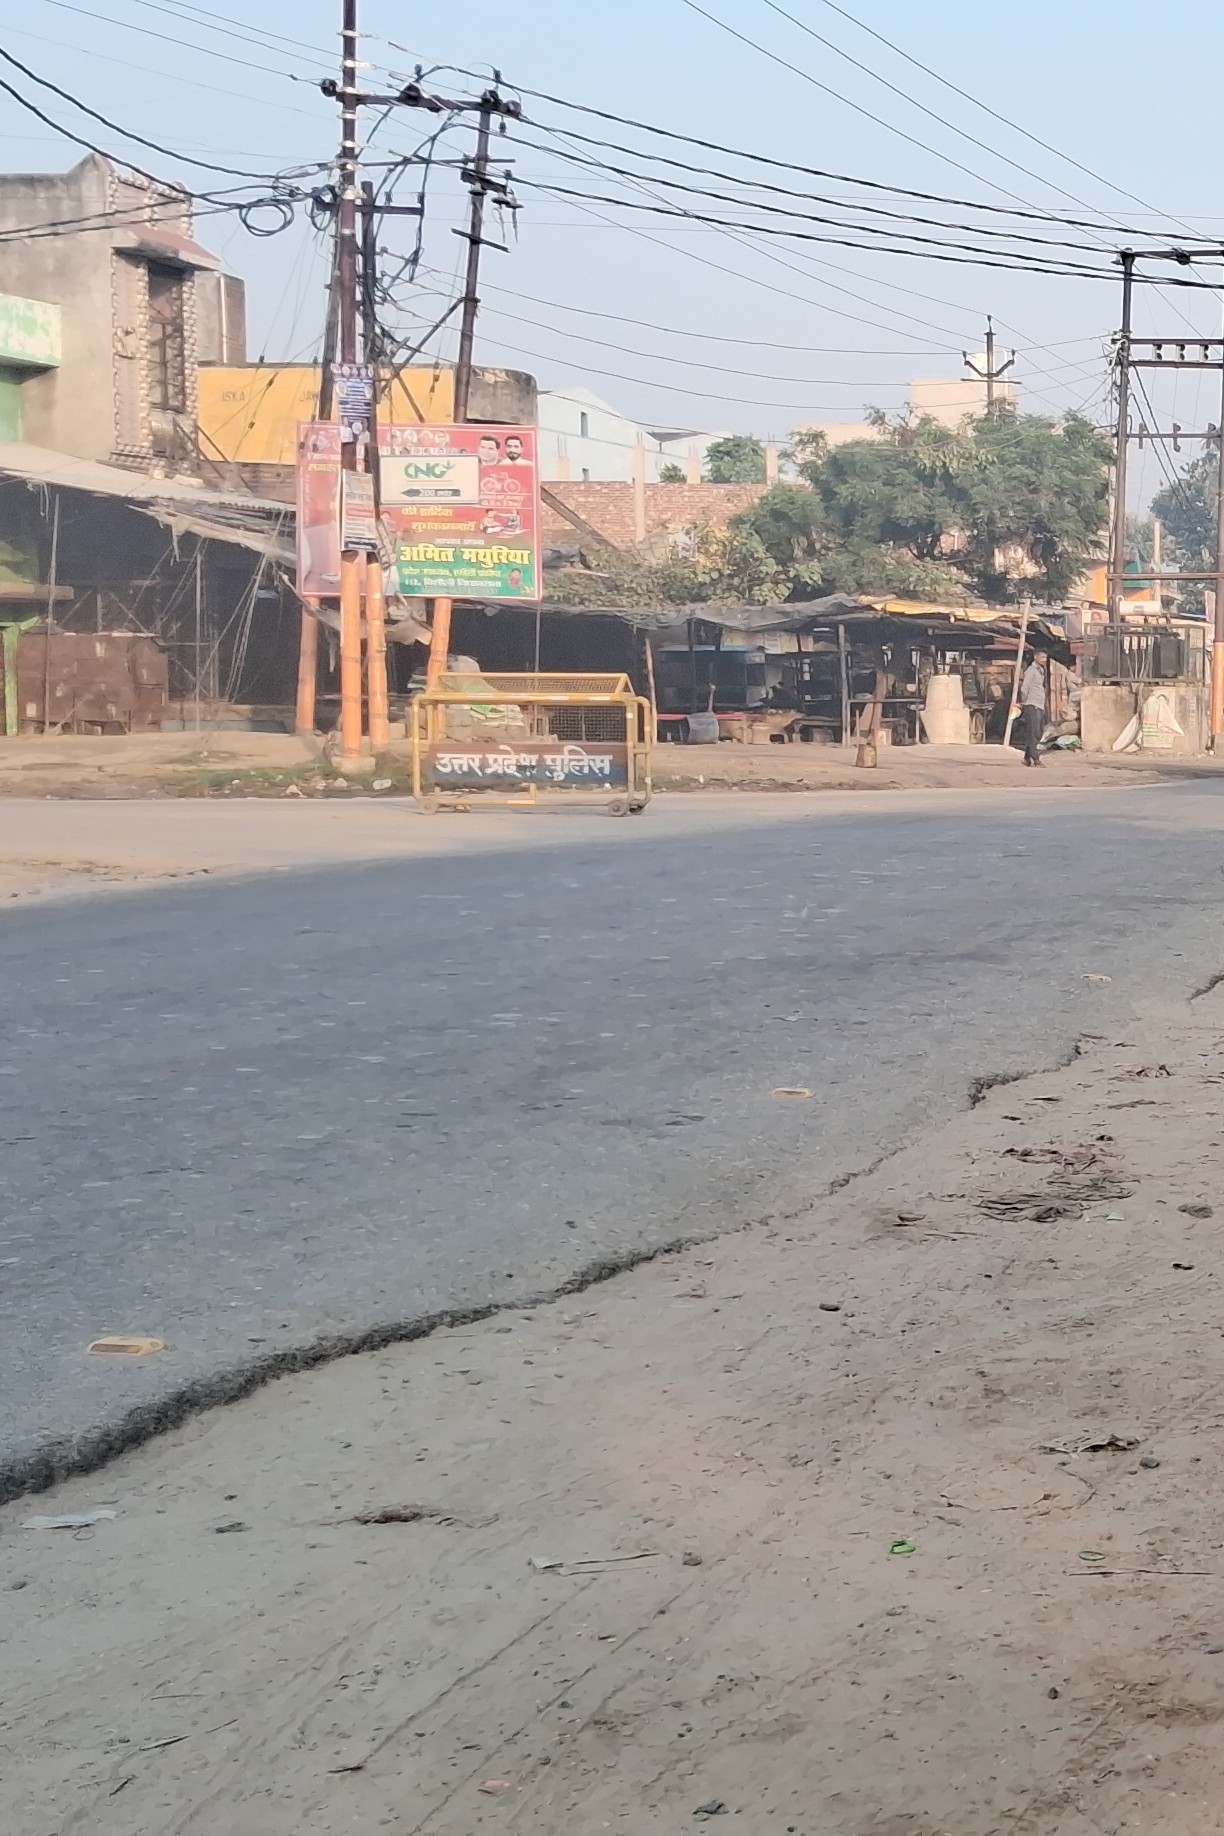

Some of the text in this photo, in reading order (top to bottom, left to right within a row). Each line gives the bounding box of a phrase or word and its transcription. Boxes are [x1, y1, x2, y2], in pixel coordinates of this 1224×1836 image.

[404, 462, 449, 479] CNG
[419, 506, 454, 517] हार्दिक
[400, 543, 455, 563] अमित
[435, 744, 613, 781] उत्तर प्रदेश पुलिस
